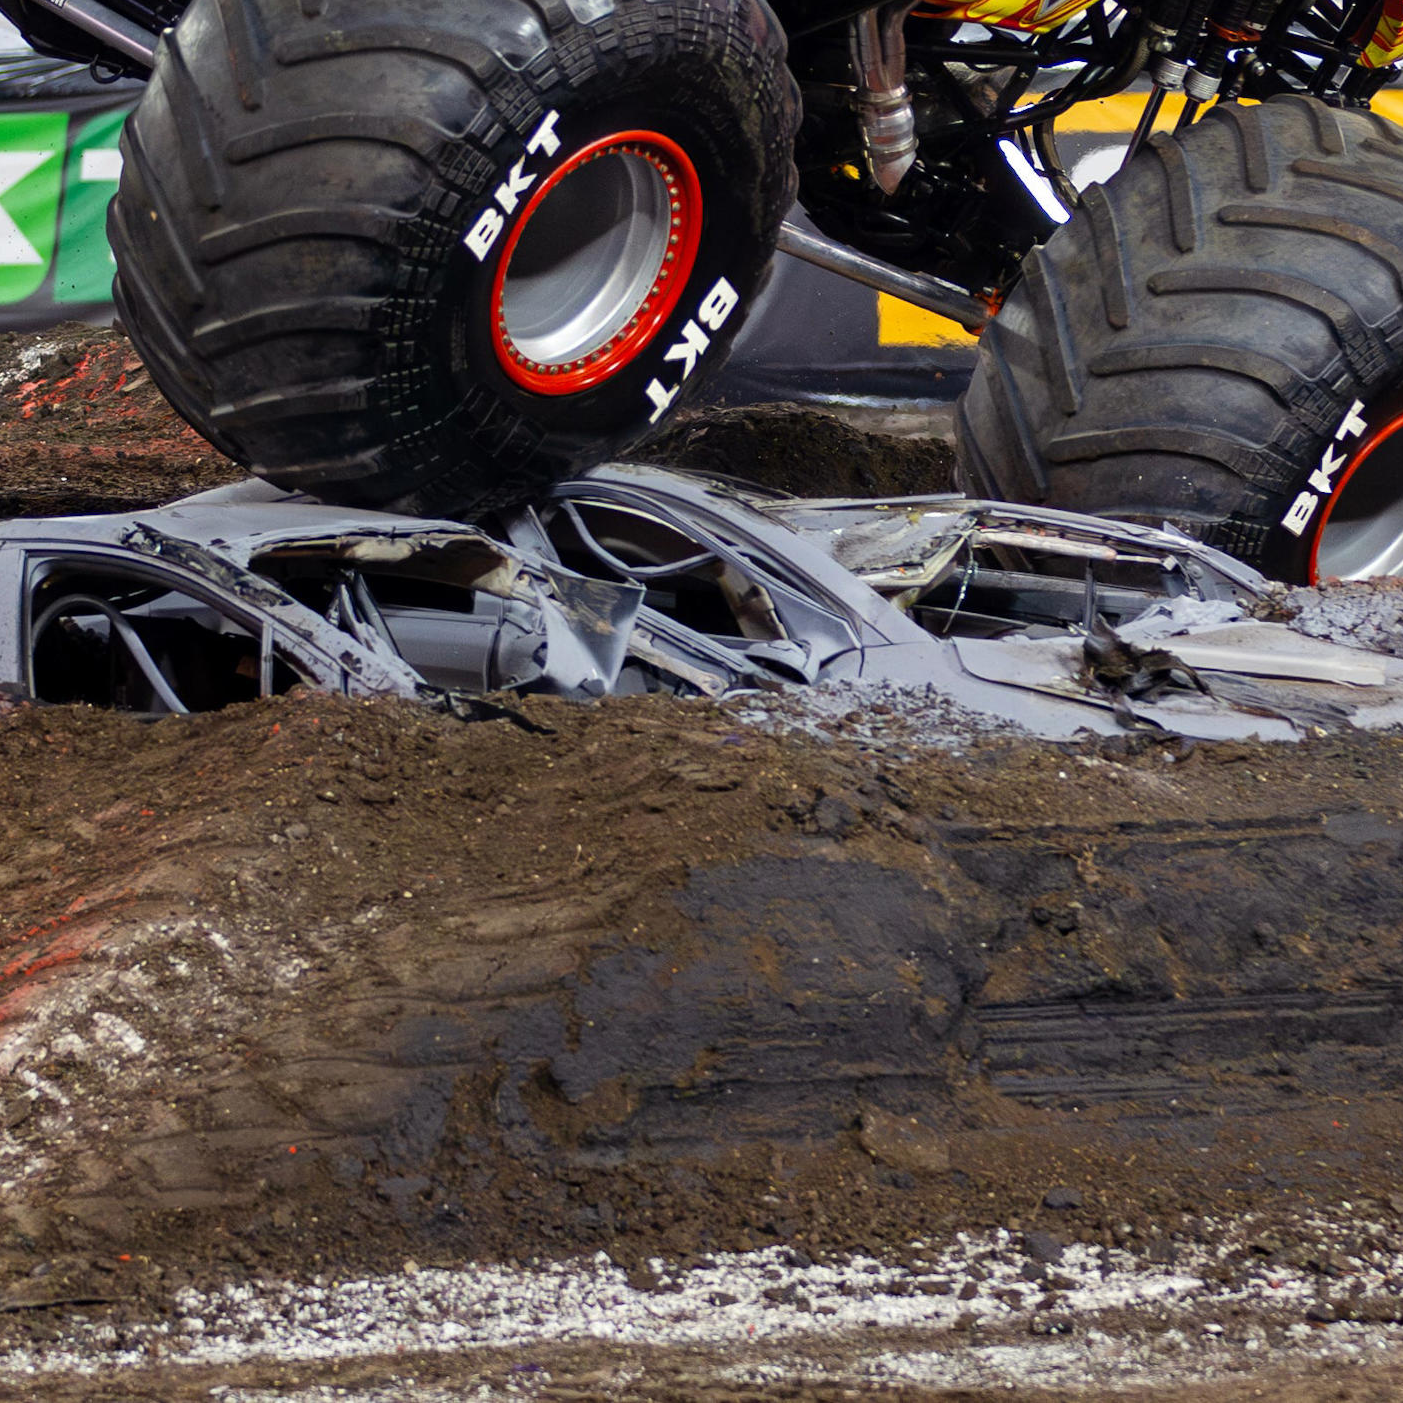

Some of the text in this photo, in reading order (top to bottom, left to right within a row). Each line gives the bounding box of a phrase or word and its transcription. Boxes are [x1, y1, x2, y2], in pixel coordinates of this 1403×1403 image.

[464, 109, 565, 262] BKT
[645, 276, 739, 424] BKT
[1280, 398, 1368, 537] BKT
